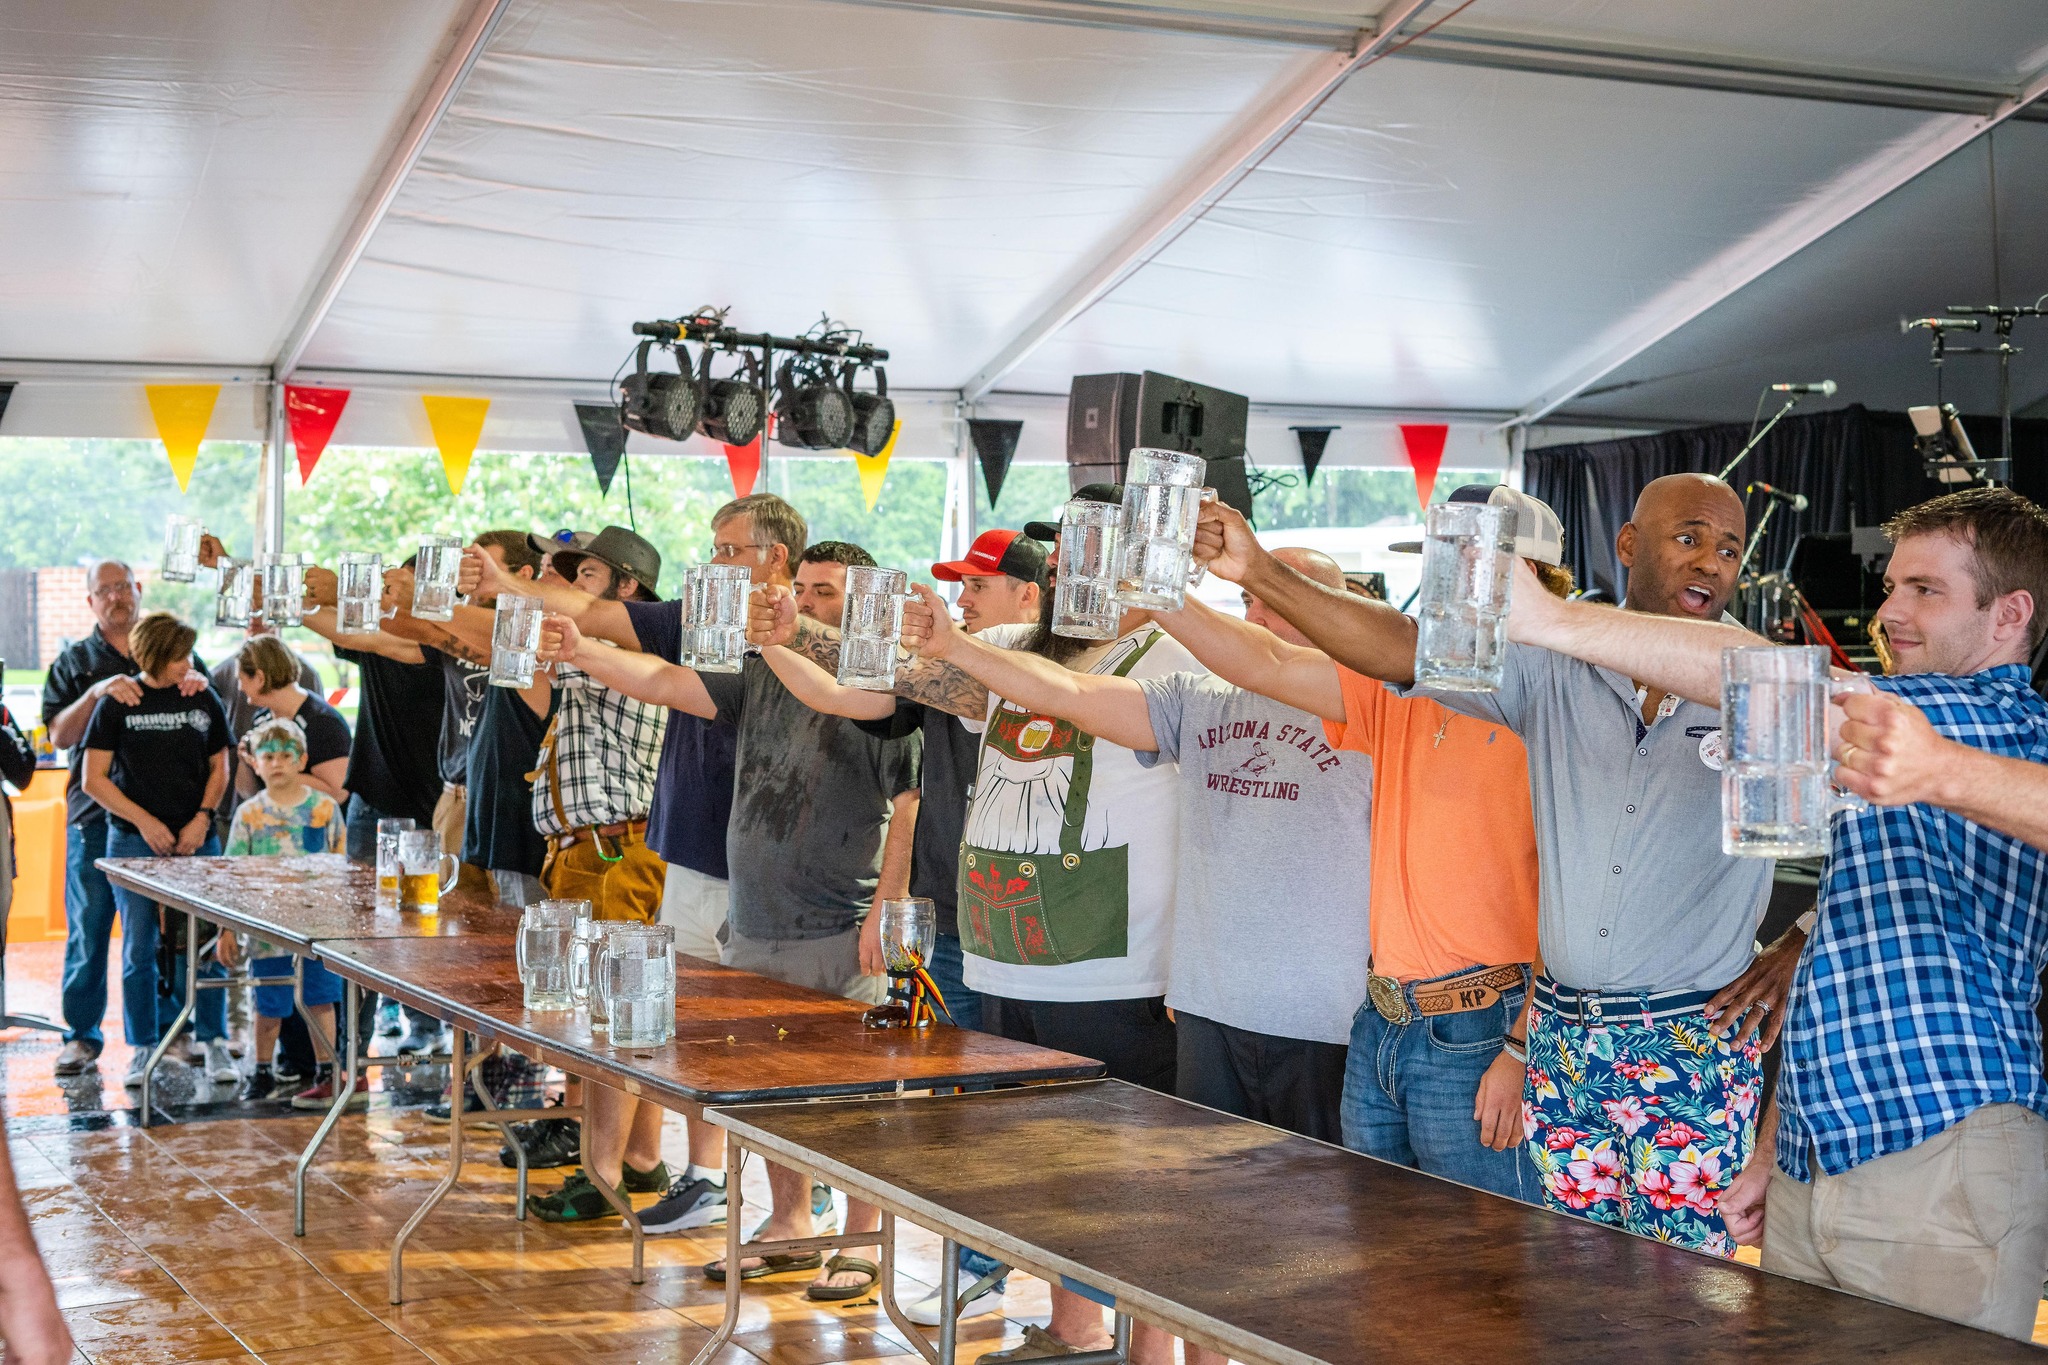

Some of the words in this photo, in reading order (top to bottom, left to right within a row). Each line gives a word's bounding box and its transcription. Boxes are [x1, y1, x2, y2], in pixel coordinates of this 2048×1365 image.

[125, 712, 187, 728] FIREHOUSE
[1197, 720, 1270, 750] ARIZONA
[1276, 724, 1341, 773] STATE
[1206, 773, 1300, 801] WRESTLING
[1459, 988, 1486, 1008] KP
